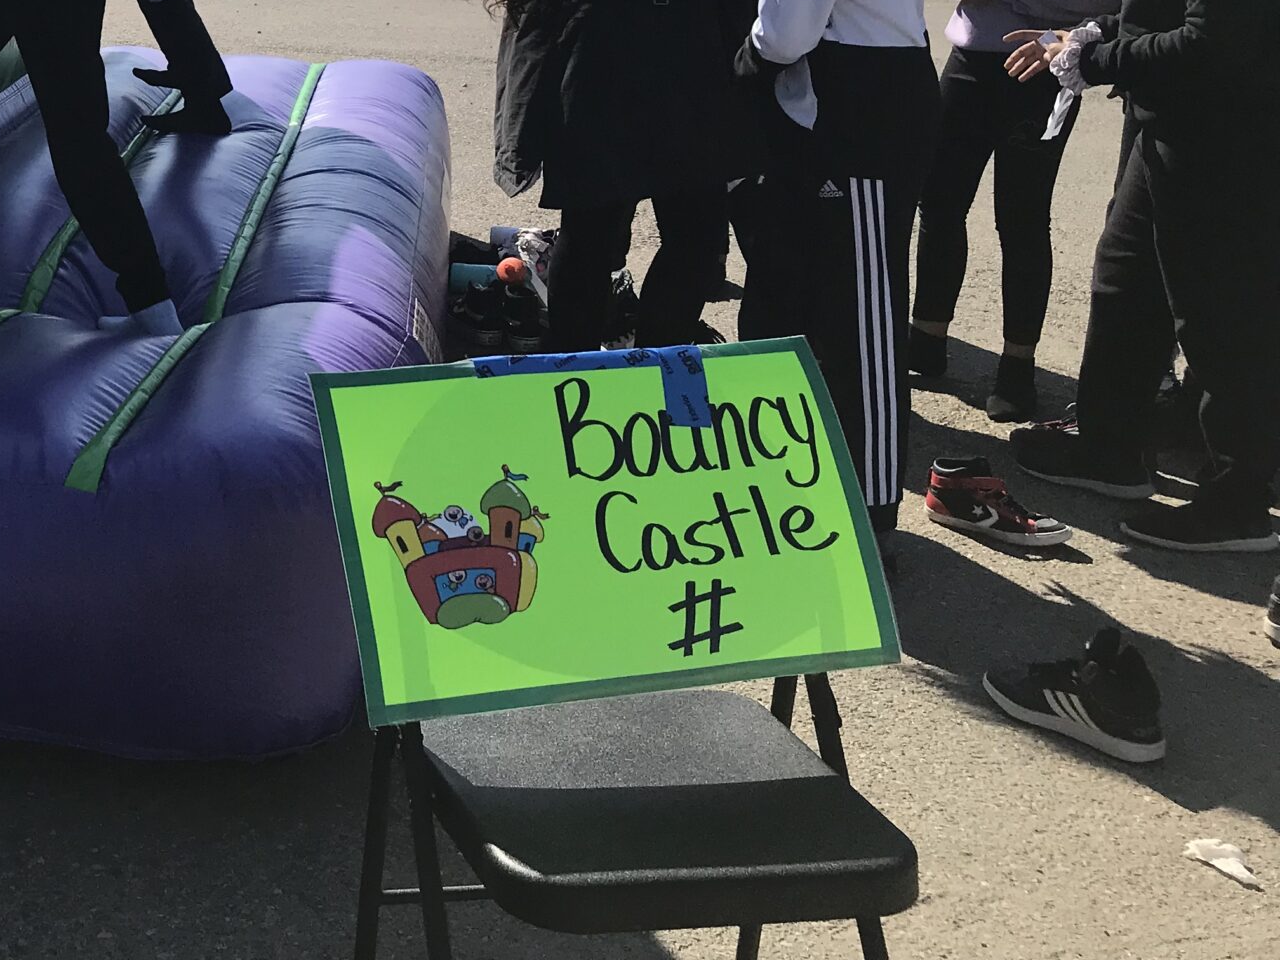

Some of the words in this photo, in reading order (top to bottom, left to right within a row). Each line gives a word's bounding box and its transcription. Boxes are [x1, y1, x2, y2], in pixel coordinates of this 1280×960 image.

[553, 376, 821, 488] Bouncy
[594, 484, 840, 574] Castle
[666, 578, 745, 657] #
